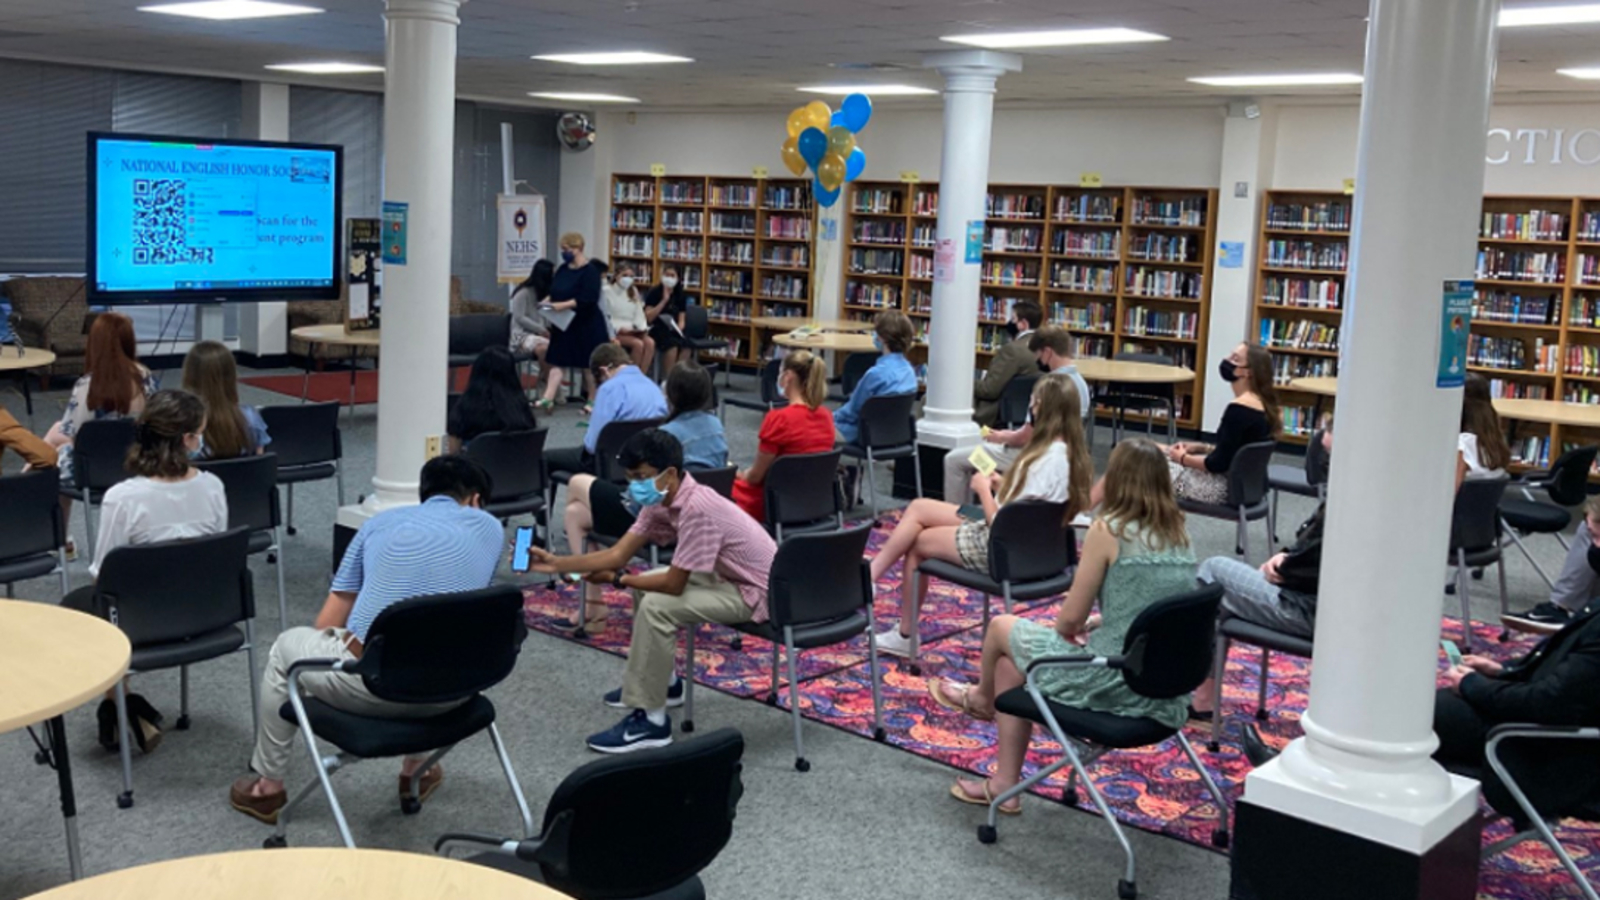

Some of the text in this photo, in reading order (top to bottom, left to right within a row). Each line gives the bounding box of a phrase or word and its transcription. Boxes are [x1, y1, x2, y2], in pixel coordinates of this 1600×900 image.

[121, 158, 179, 174] NATIONAL
[181, 160, 229, 175] ENGLISH
[231, 163, 271, 178] HONOR
[282, 213, 298, 227] for
[301, 214, 318, 227] the
[278, 234, 325, 247] program
[506, 240, 538, 253] NEHS
